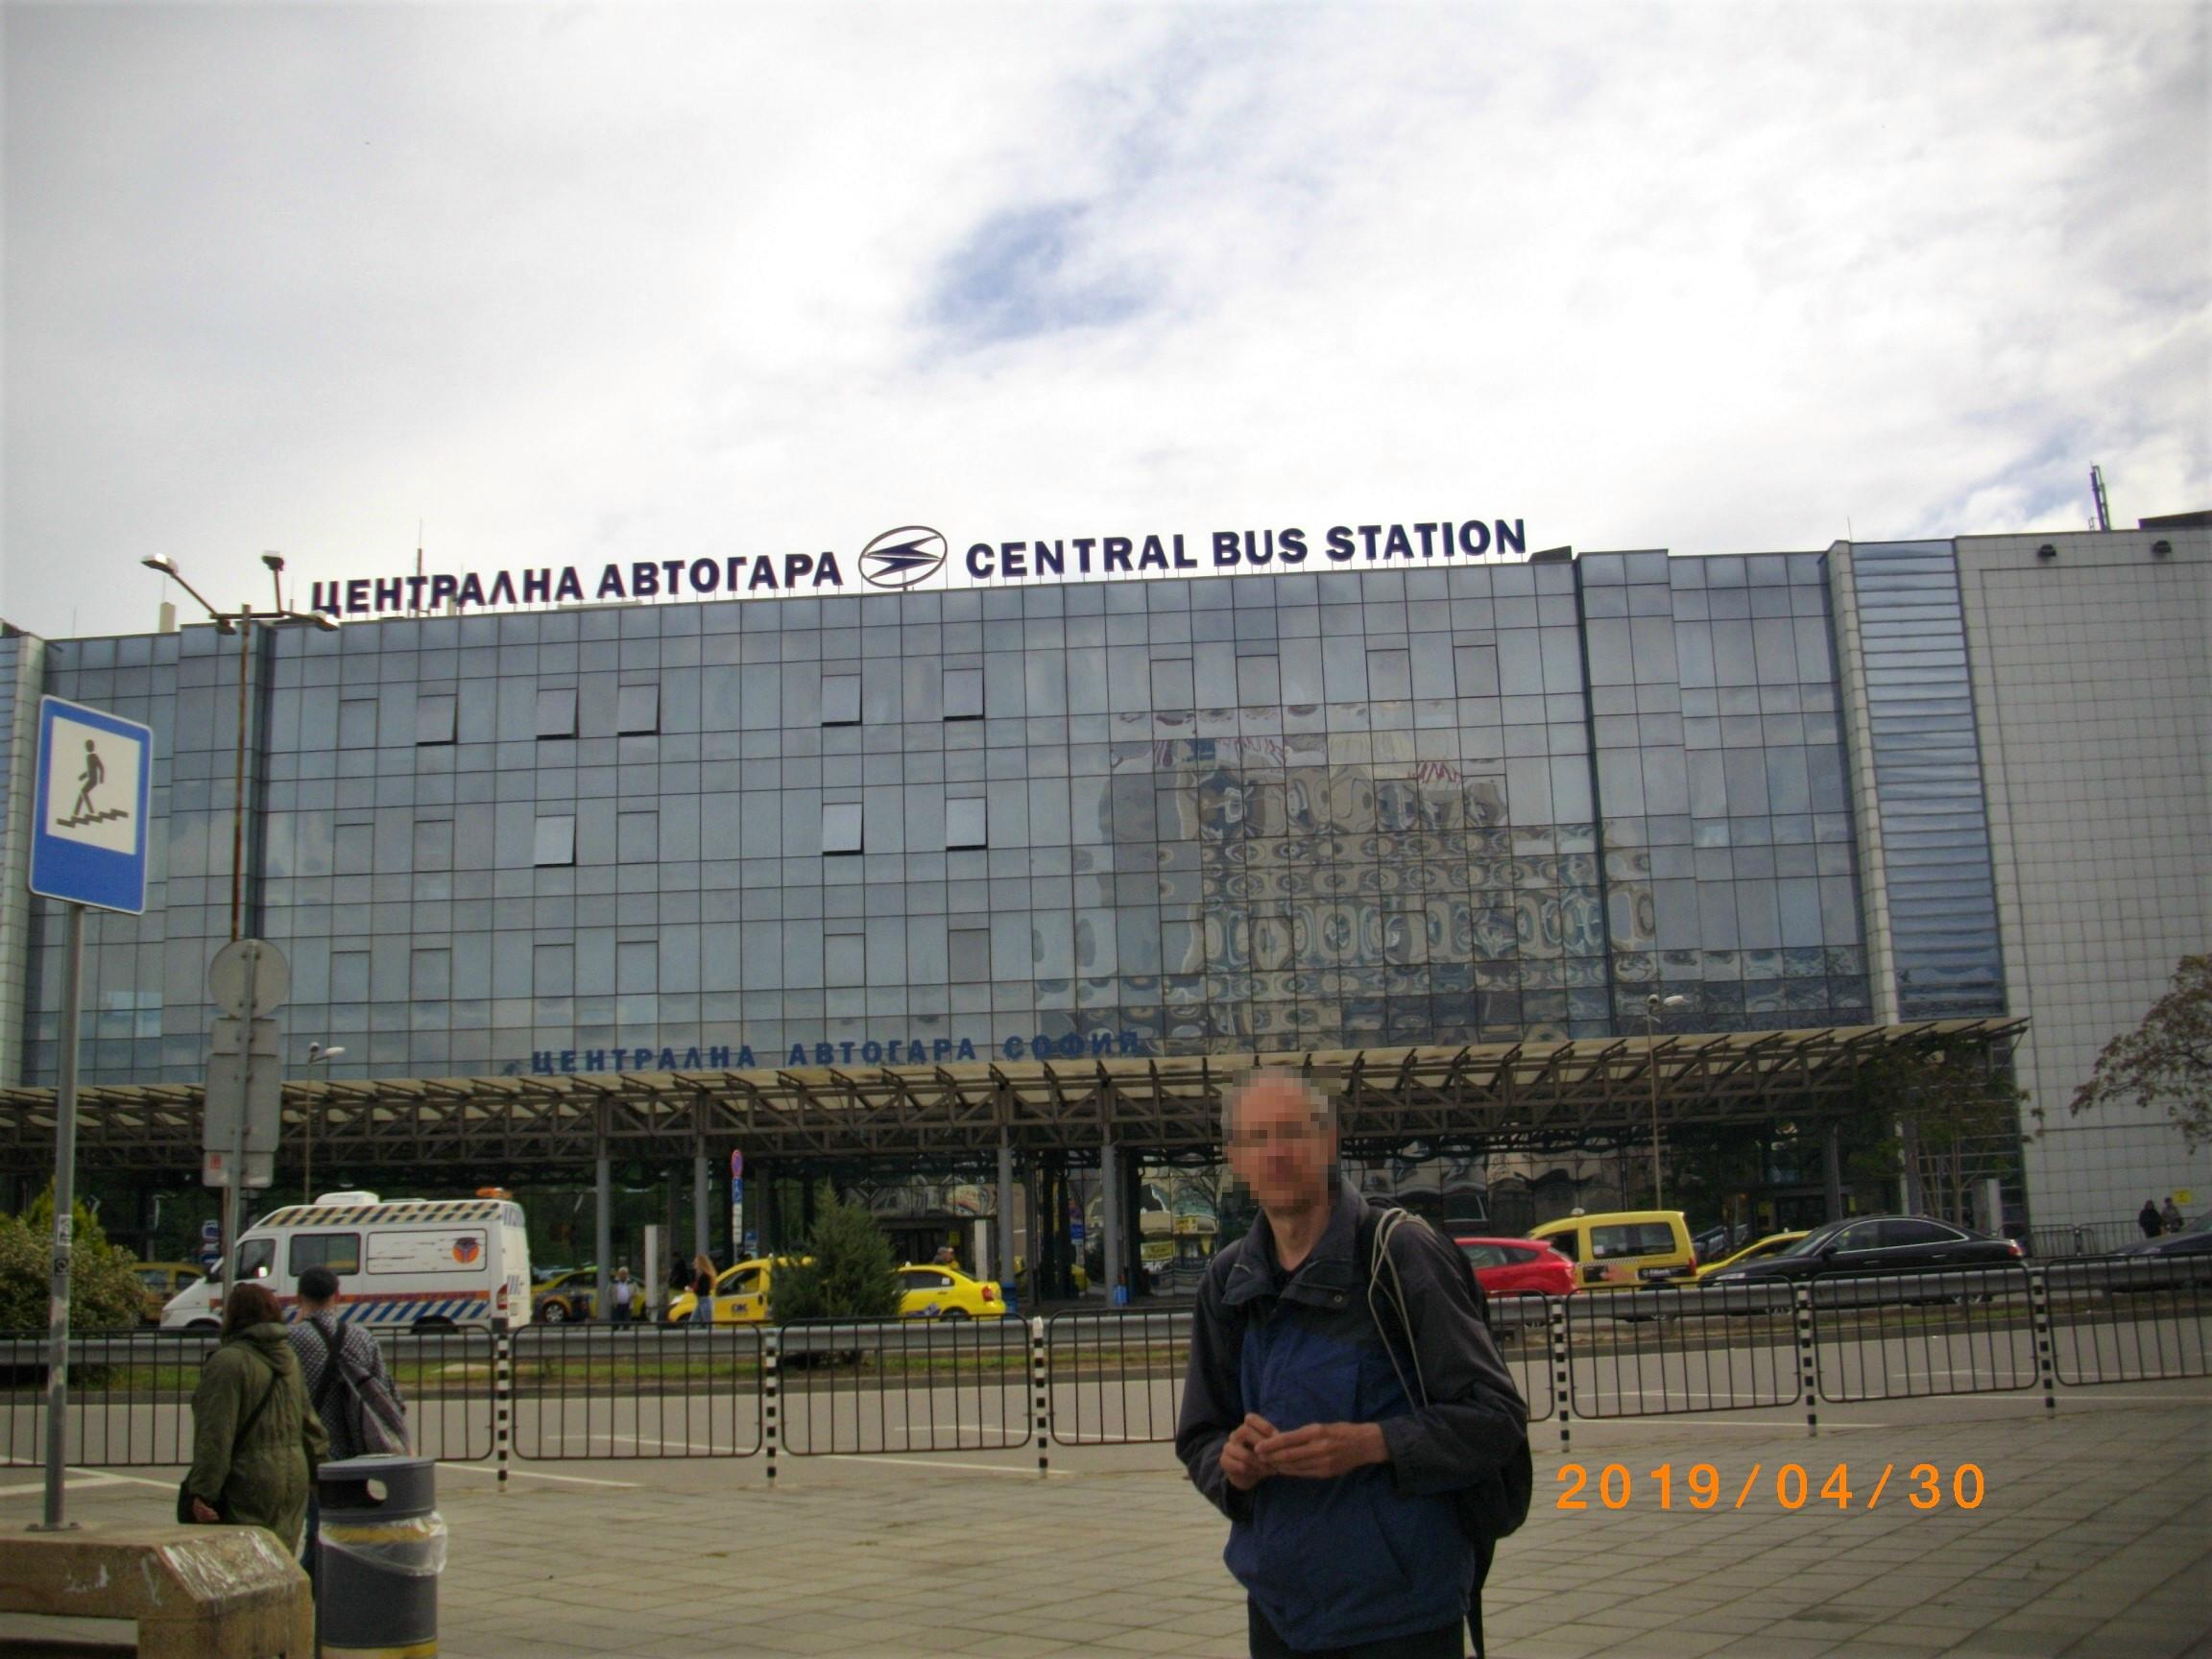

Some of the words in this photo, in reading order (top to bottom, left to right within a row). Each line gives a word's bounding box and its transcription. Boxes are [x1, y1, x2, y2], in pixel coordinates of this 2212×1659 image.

[965, 533, 1197, 579] CENTRAL
[1212, 528, 1309, 566] BUS
[1325, 518, 1527, 561] STATION
[312, 565, 584, 617] ЦЕНТРАЛНА
[596, 551, 843, 599] АВТОГАРА
[532, 1045, 757, 1074] ЦЕНТРАЛНА
[788, 1037, 975, 1066] АВТОГАРА
[1002, 1031, 1139, 1060] СОФИЯ
